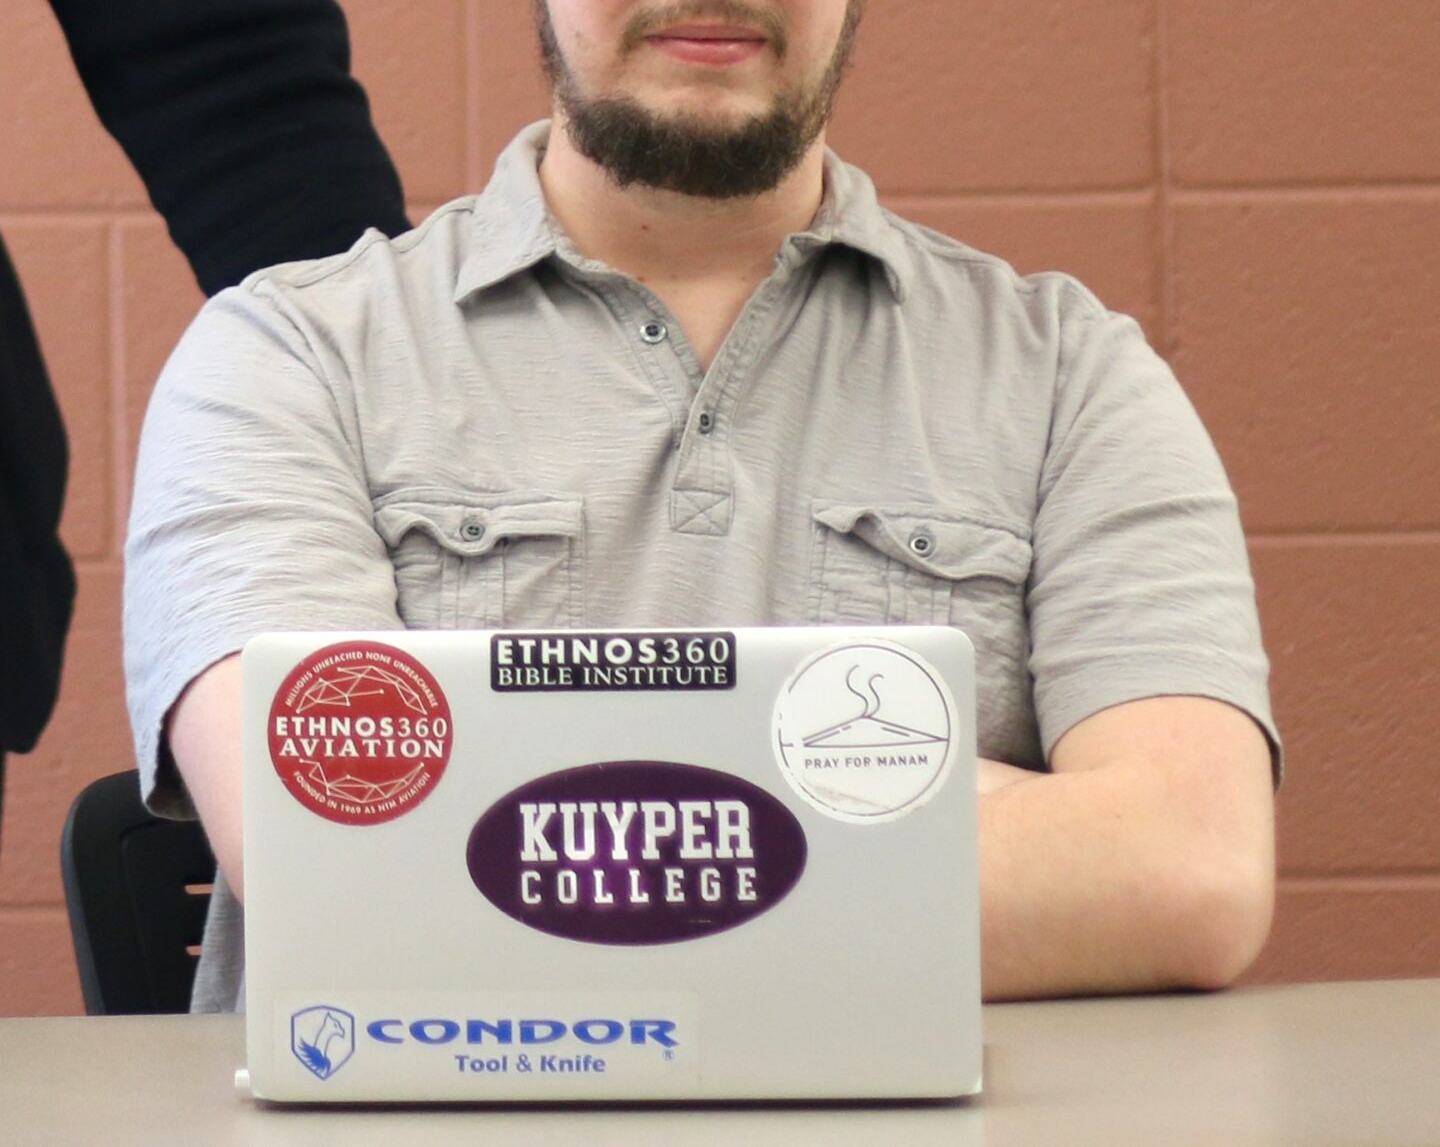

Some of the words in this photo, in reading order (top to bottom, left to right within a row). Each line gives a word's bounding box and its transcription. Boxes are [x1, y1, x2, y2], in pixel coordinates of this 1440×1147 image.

[497, 638, 729, 664] ETHNOS360
[285, 672, 313, 707] MILLIONS
[313, 651, 363, 673] UNREACHED
[366, 651, 391, 664] NONE
[394, 660, 439, 708] UNREACHABLE
[498, 667, 573, 685] BIBLE
[583, 666, 728, 685] INSTITUTE
[276, 716, 447, 738] ETHNOS360
[279, 738, 445, 758] AVIATION
[805, 757, 840, 769] PRAY
[845, 757, 872, 768] FOR
[877, 755, 928, 767] MANAM
[293, 770, 326, 803] FOUNDED
[327, 799, 337, 809] IN
[340, 804, 361, 814] 1969
[364, 806, 376, 814] AS
[379, 800, 397, 812] NTM
[399, 772, 430, 804] AVIATION
[520, 800, 754, 861] KUYPER
[521, 867, 757, 904] COLLEGE
[366, 1019, 679, 1048] CONDOR
[454, 1054, 508, 1073] Tool
[516, 1054, 533, 1073] &
[540, 1054, 606, 1073] Knife
